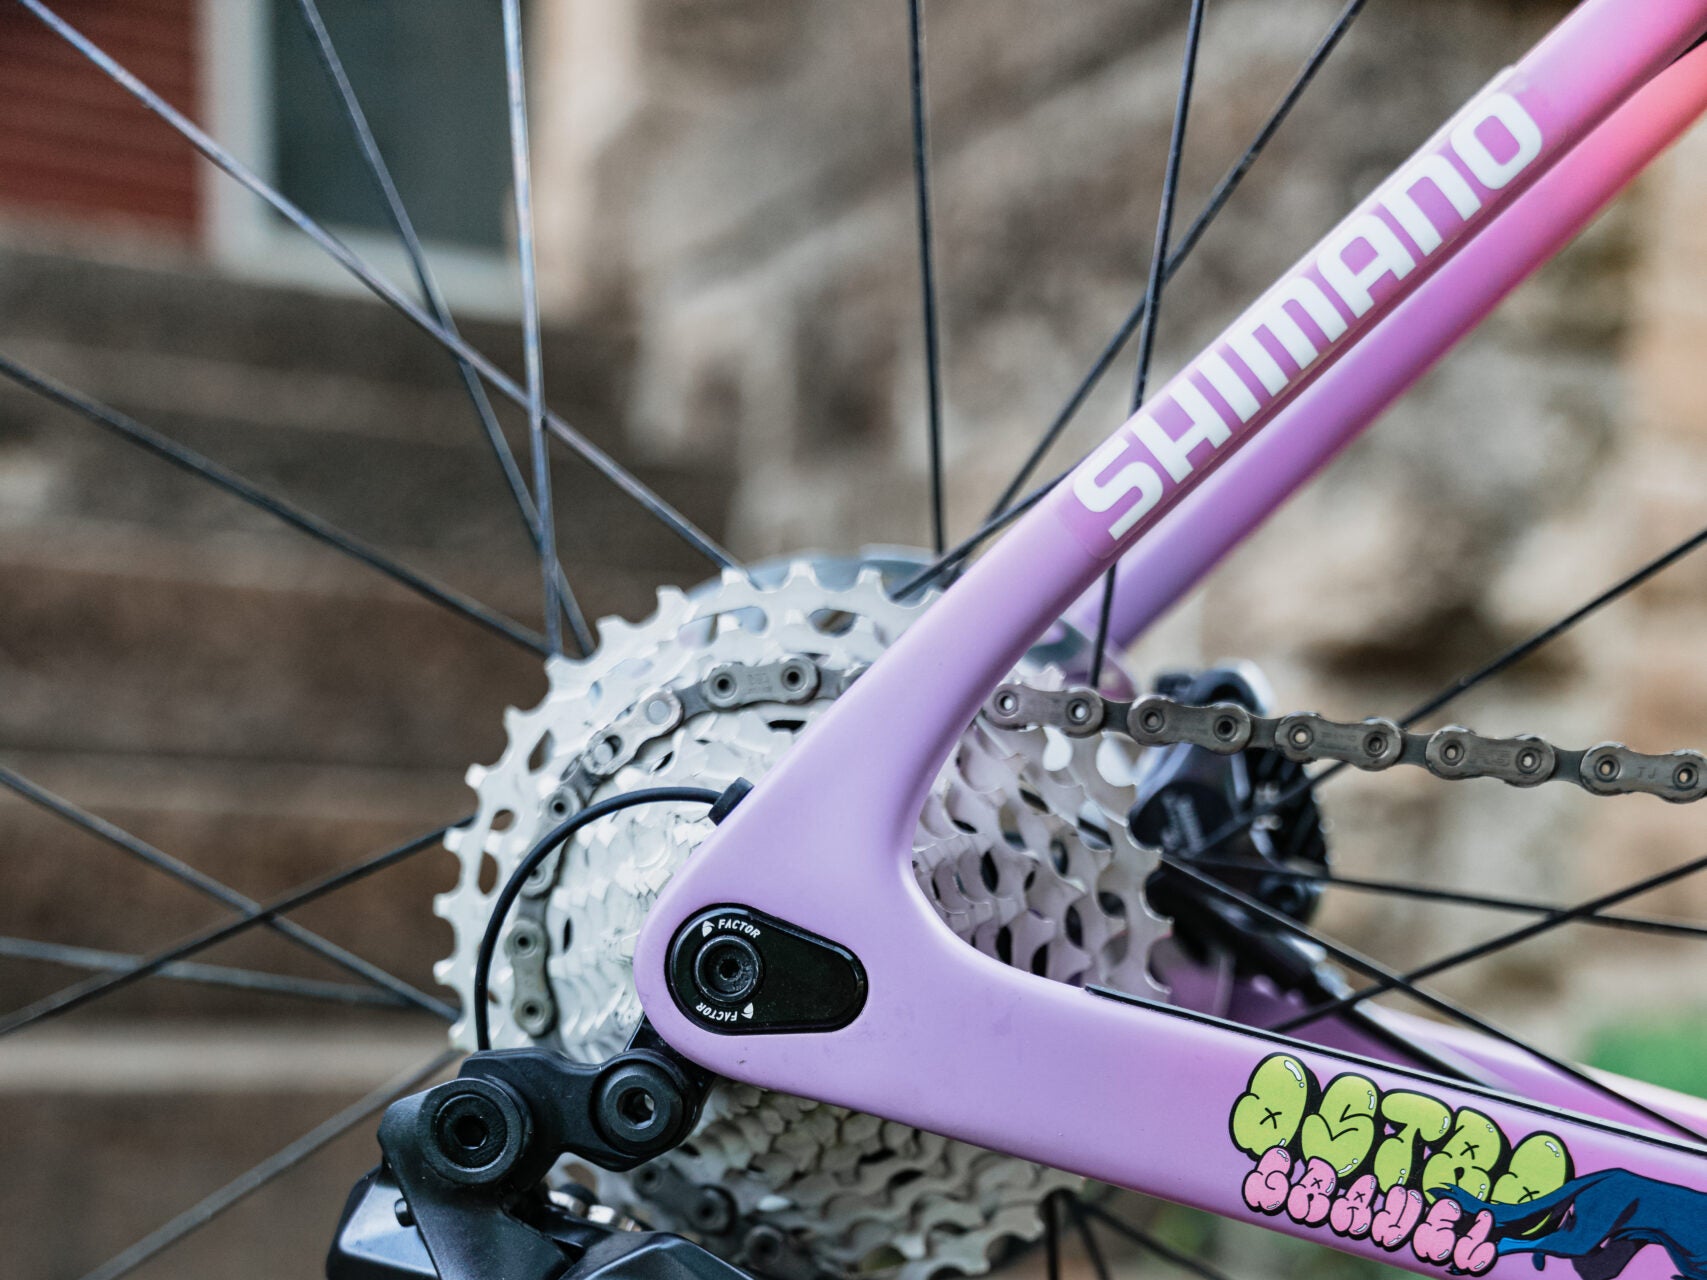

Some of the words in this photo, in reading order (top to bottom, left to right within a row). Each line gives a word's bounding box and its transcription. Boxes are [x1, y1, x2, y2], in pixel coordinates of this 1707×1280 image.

[1073, 92, 1543, 541] SHIMANO
[717, 918, 761, 939] FACTOR
[695, 1001, 739, 1022] FACTOR
